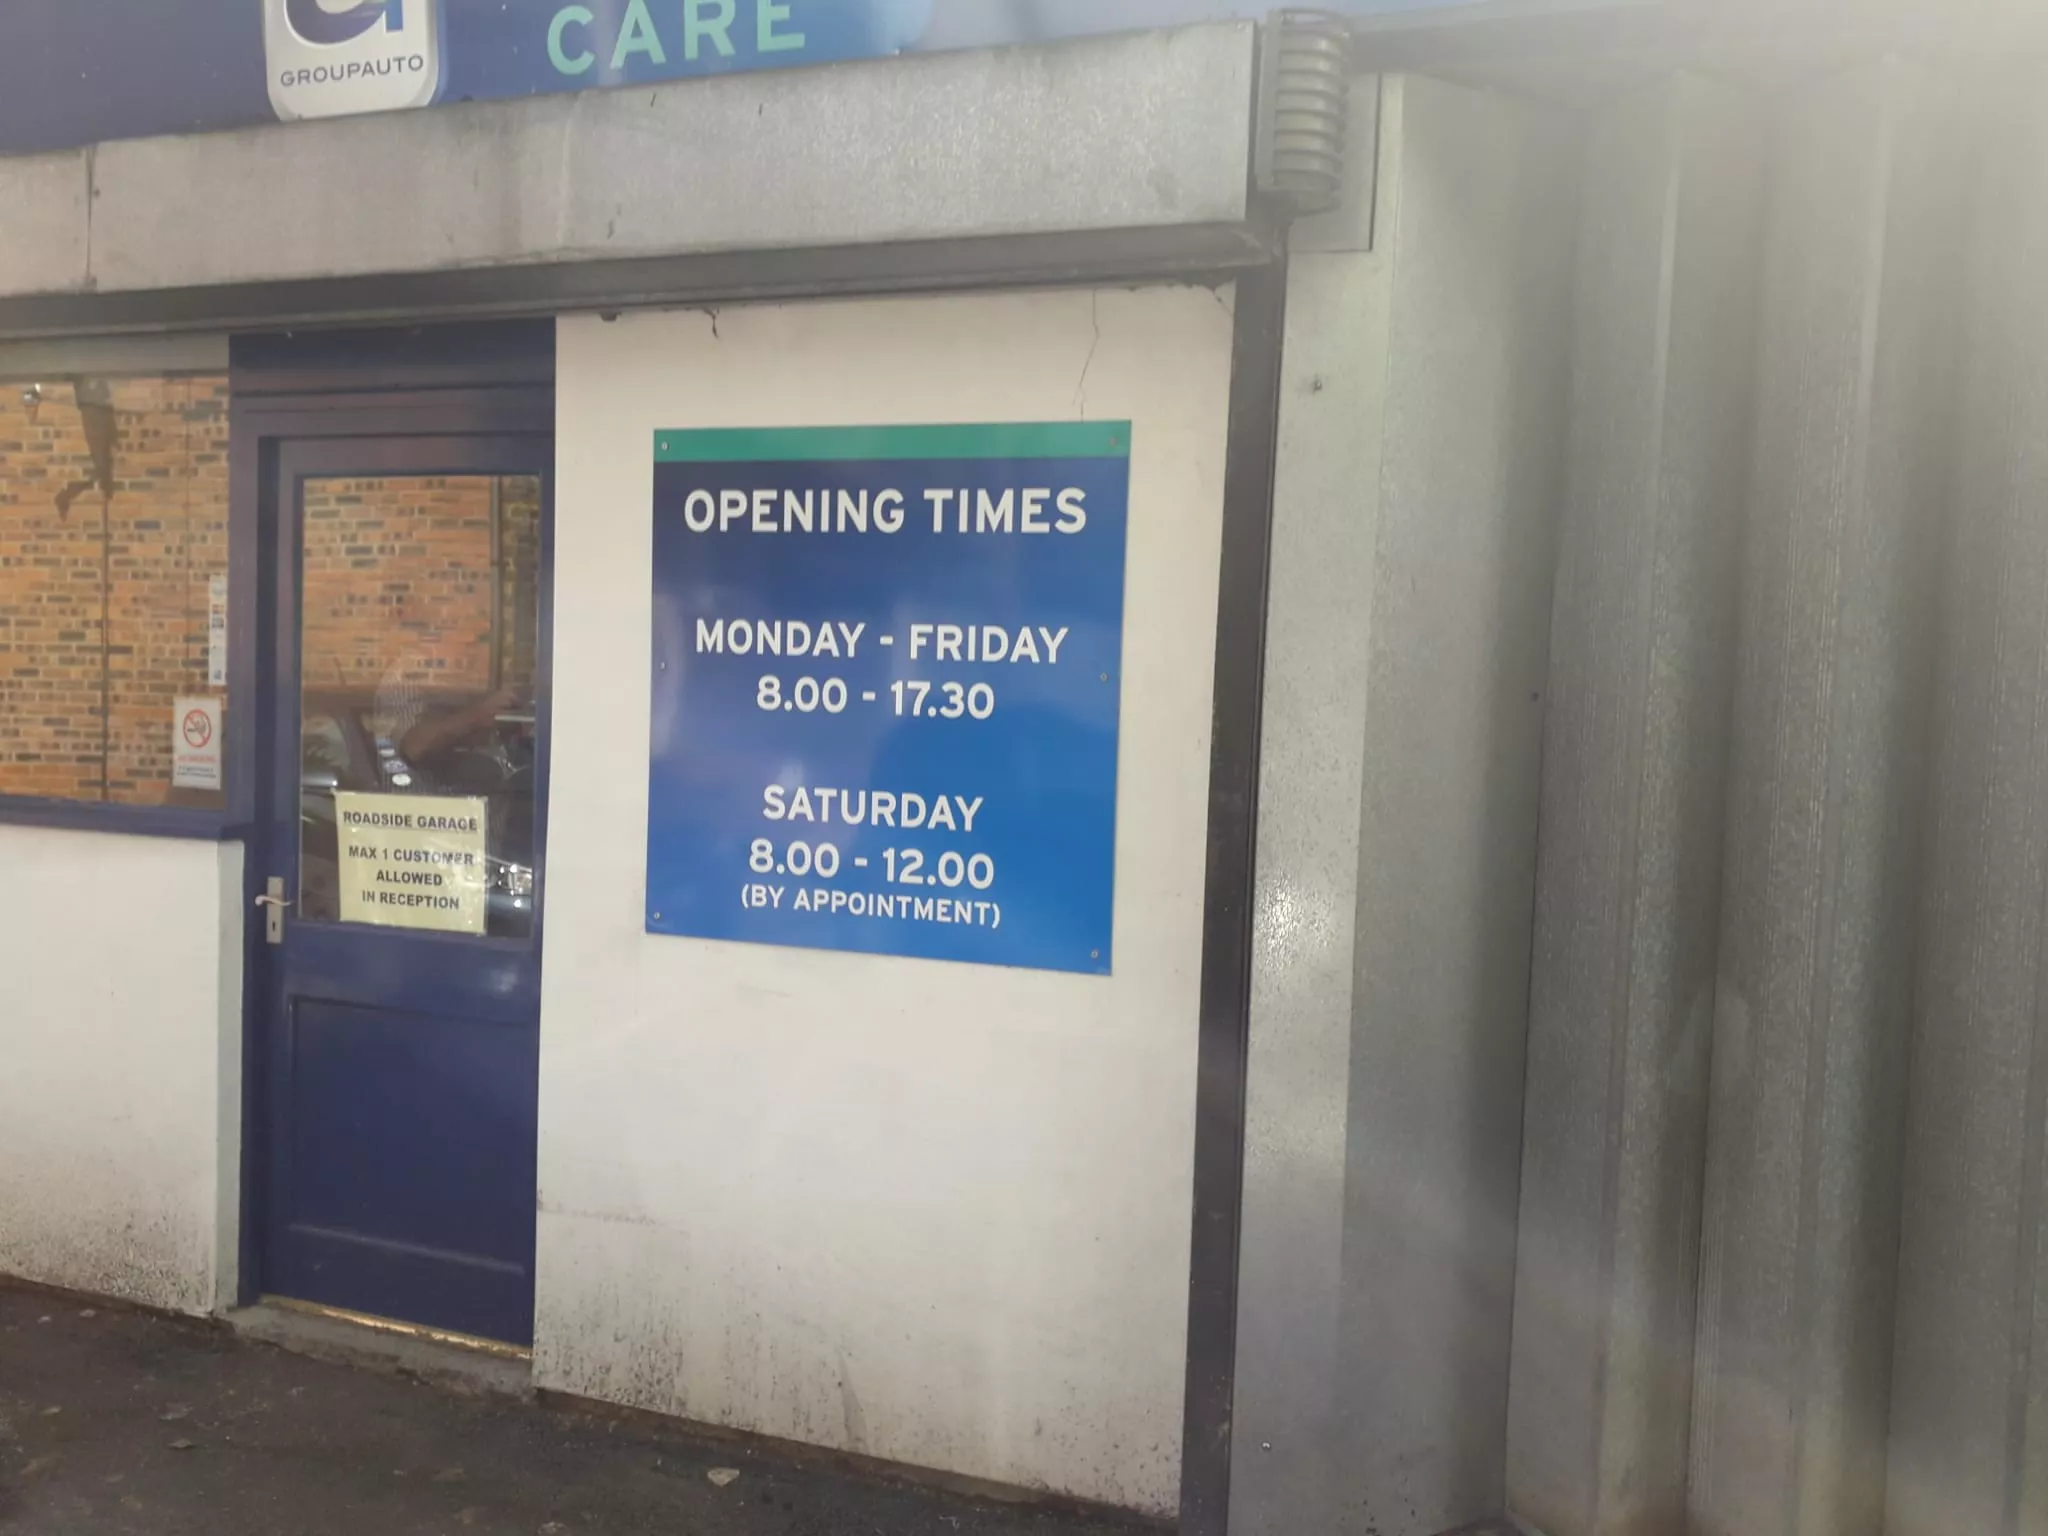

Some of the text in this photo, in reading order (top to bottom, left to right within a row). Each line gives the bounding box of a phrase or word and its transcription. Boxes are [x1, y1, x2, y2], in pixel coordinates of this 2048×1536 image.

[547, 0, 806, 75] CARE
[280, 55, 424, 87] GROUPAUTO
[684, 487, 1086, 533] OPENING TIMES
[695, 618, 865, 658] MONDAY
[909, 623, 1069, 664] FRIDAY
[756, 675, 848, 713] 8.00
[890, 679, 995, 719] 17.30
[343, 811, 478, 831] ROADSIDE GARAGE
[762, 783, 983, 831] SATURDAY
[348, 845, 474, 865] MAX 1 CUSTOMER
[376, 869, 442, 886] ALLOWED
[748, 838, 840, 878] 8.00
[882, 847, 994, 889] 12.00
[362, 890, 460, 909] IN RECEPTION
[741, 883, 1000, 929] (BY APPOINTMENT)
